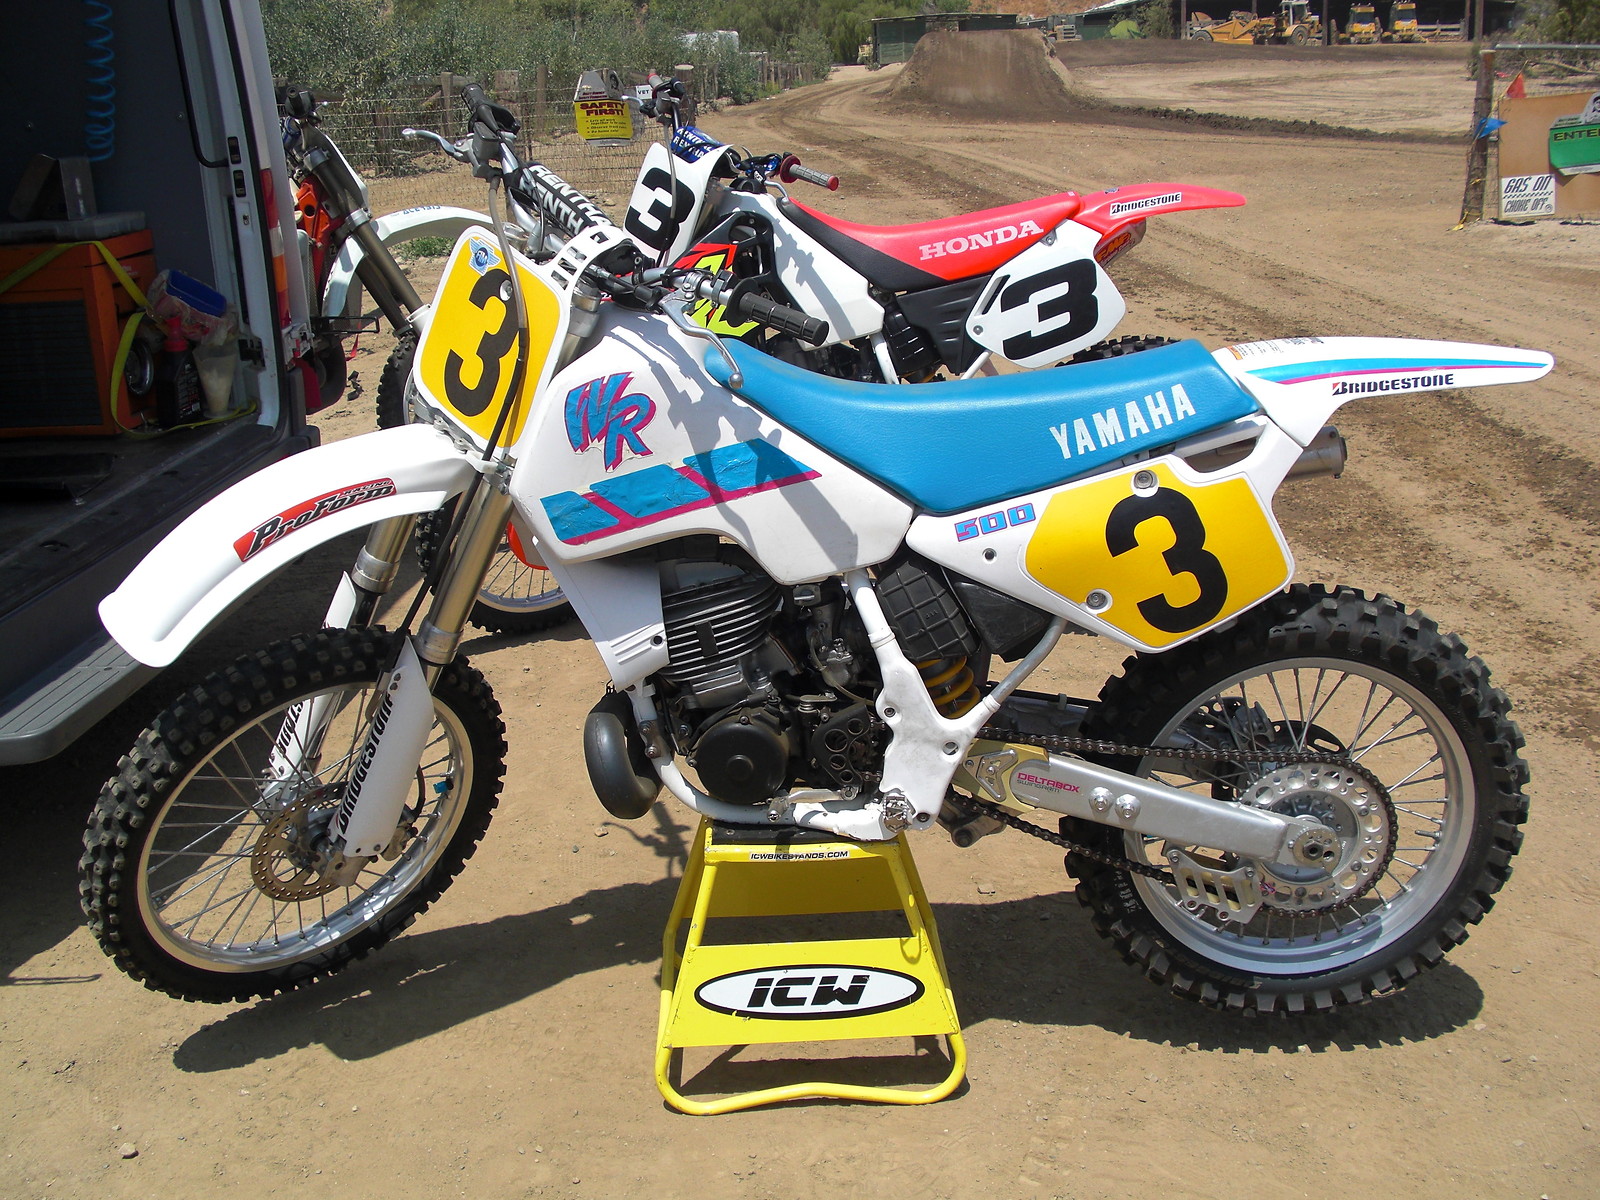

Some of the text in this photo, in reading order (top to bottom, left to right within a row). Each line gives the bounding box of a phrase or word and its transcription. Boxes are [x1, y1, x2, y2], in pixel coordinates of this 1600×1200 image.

[580, 101, 625, 110] SAFETY
[586, 109, 625, 117] FIRST!
[673, 135, 705, 158] RENTHA
[528, 164, 614, 227] RENTHA
[1504, 175, 1553, 194] GAS ON
[519, 176, 585, 236] RENTH
[625, 167, 695, 251] 3
[1111, 193, 1181, 214] BRIDGESTONE
[1531, 197, 1549, 211] OFF
[919, 220, 1044, 261] HONDA
[1000, 258, 1099, 360] 3
[444, 268, 521, 417] 3
[1332, 373, 1454, 396] BRIDGESTONE
[564, 371, 657, 473] WR
[1049, 383, 1196, 460] YAMAHA
[954, 502, 1036, 542] 500
[1105, 486, 1228, 634] 3
[1017, 772, 1080, 793] DELTABOX
[750, 851, 848, 860] ICWBIKESTANDS.COM
[747, 974, 870, 1008] ICW
